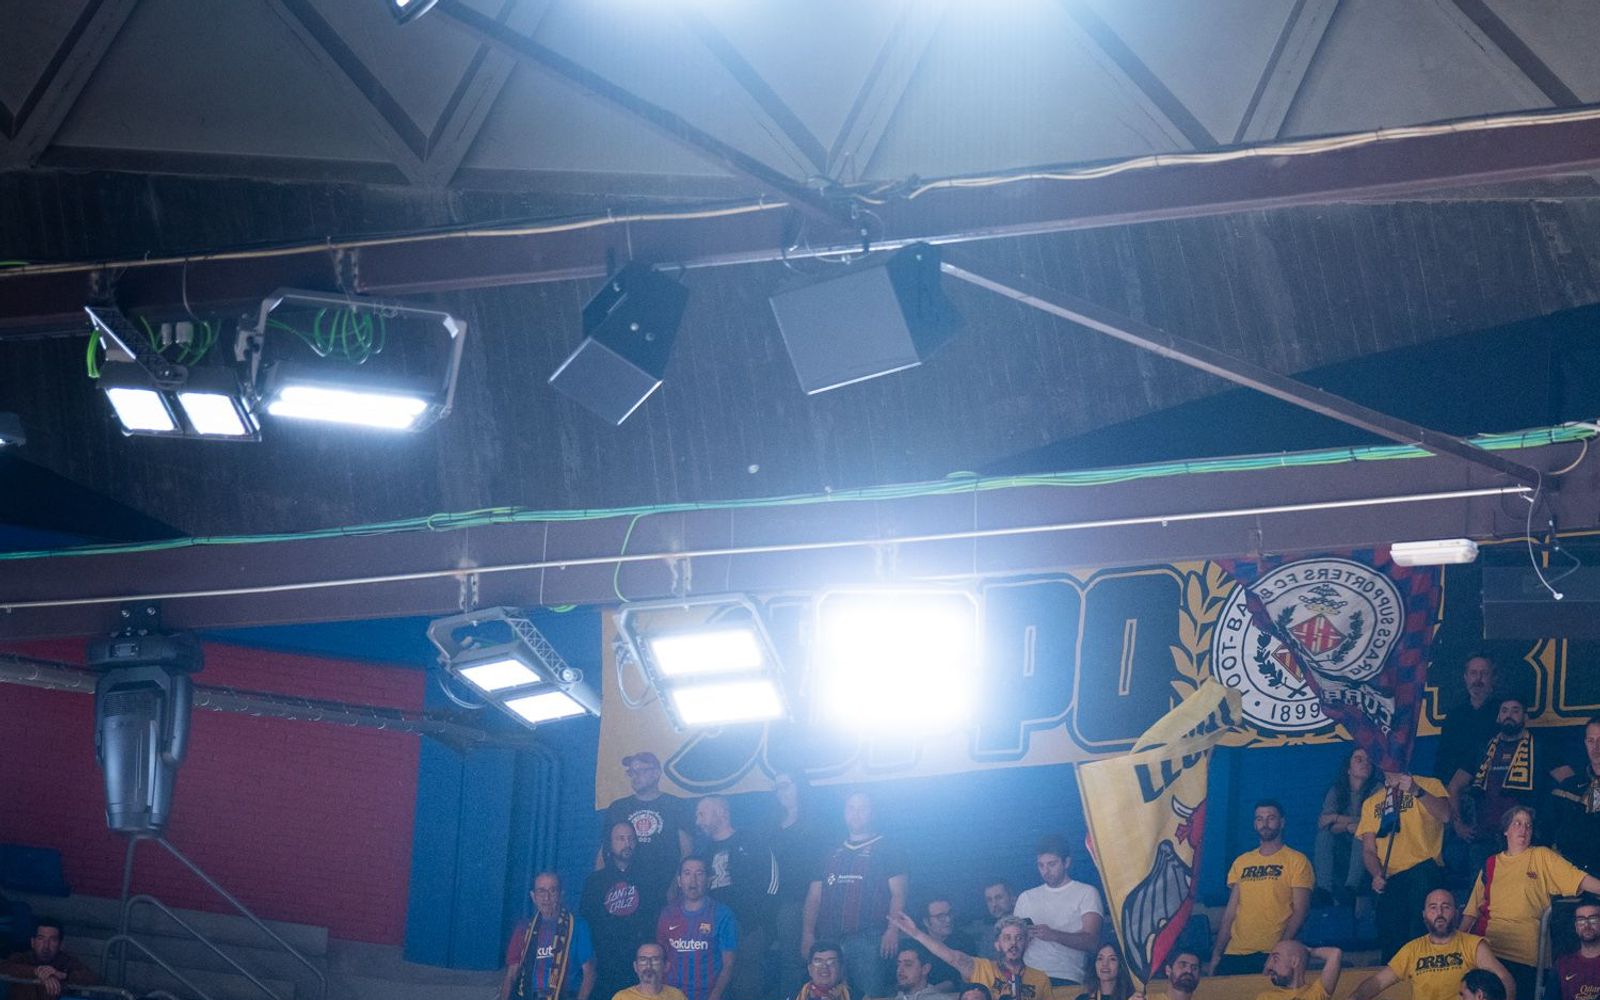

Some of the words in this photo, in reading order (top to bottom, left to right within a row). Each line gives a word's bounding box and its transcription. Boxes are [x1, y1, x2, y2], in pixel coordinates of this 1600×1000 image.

[1271, 703, 1321, 721] 1899
[1241, 864, 1283, 880] DRACS
[1417, 953, 1463, 971] DRACS
